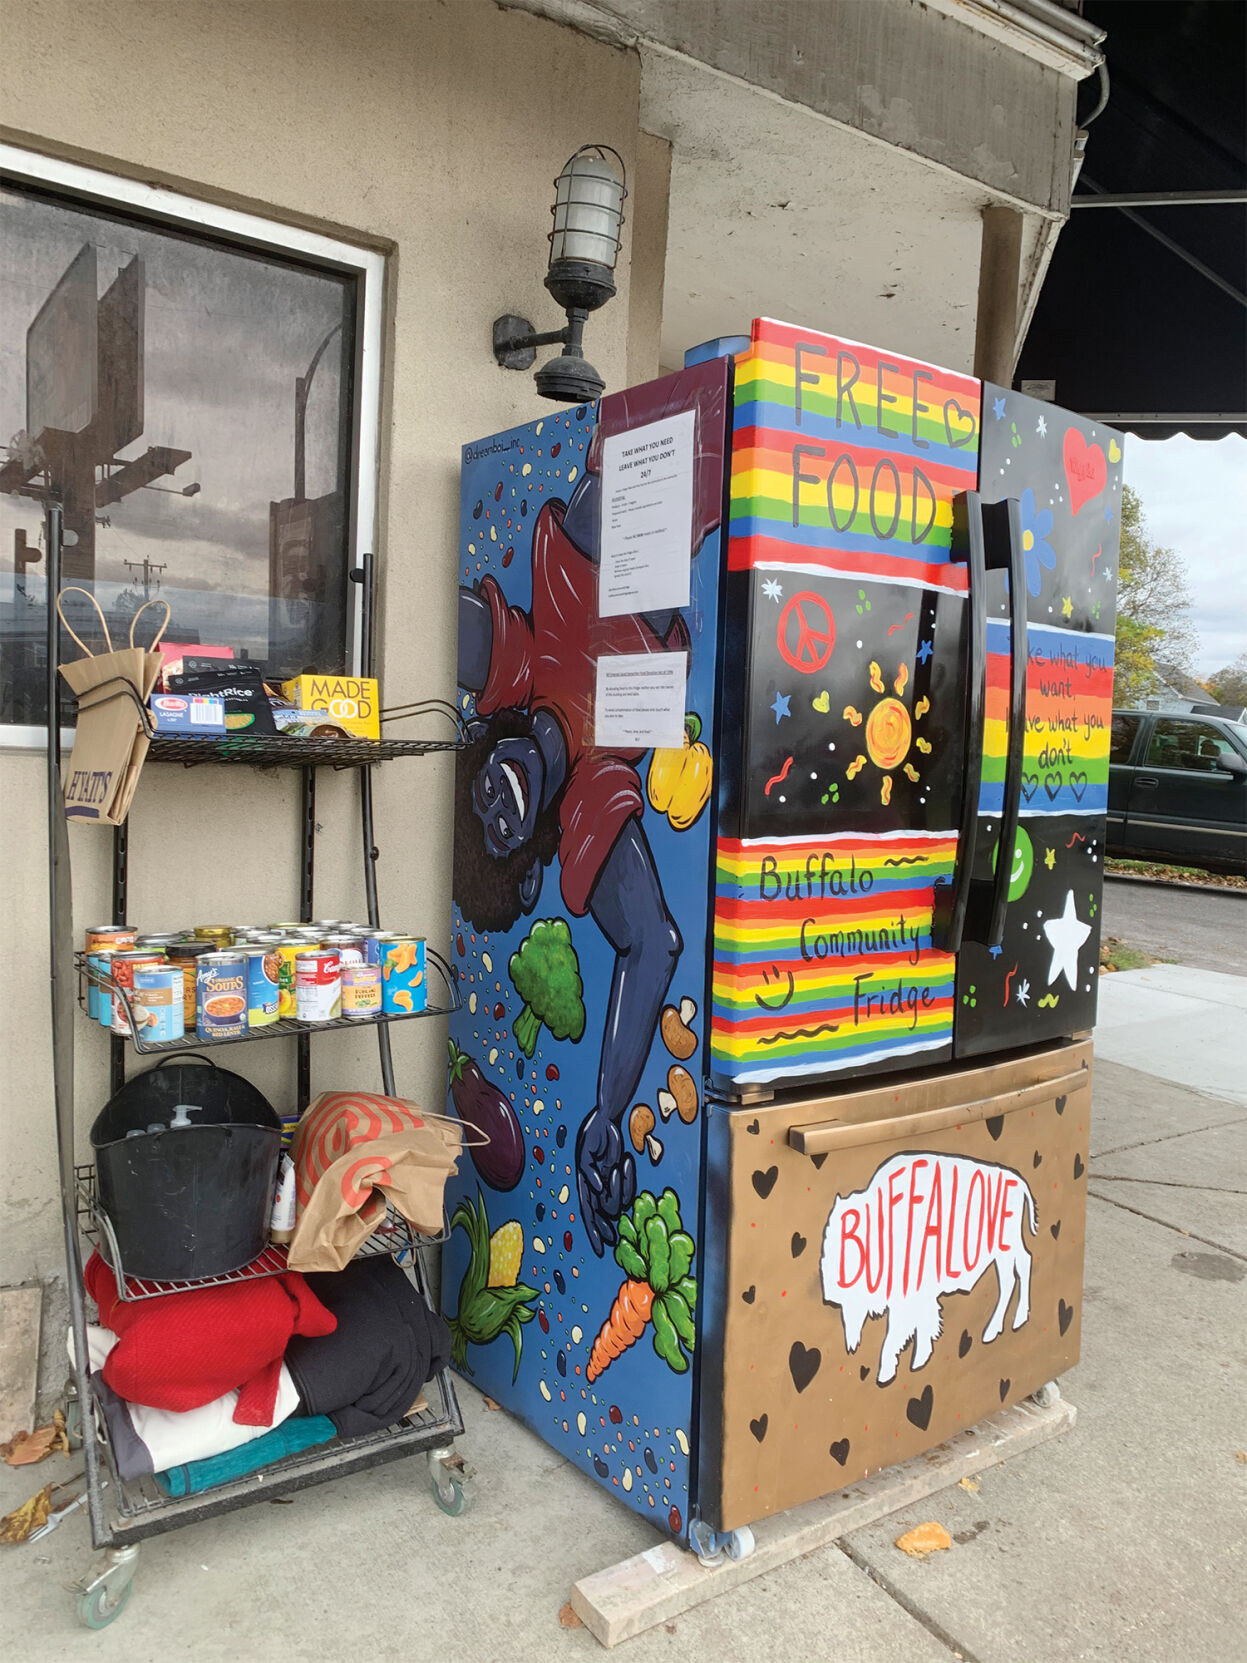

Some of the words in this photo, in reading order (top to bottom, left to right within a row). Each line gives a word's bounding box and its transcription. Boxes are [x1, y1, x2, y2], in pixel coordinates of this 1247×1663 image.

[795, 341, 933, 449] FREE
[619, 462, 633, 472] LEAVE
[634, 457, 648, 467] WHAT
[648, 454, 660, 463] YOU
[660, 449, 676, 460] DON'T
[622, 448, 633, 458] TAKE
[634, 444, 649, 454] WHAT
[649, 441, 660, 450] YOU
[660, 436, 674, 446] NEED
[640, 469, 652, 479] 24/7
[793, 444, 936, 545] FOOD
[1049, 643, 1080, 671] what
[1085, 652, 1107, 679] you
[311, 679, 370, 699] MADE
[311, 698, 372, 719] GOOD
[1005, 707, 1045, 733] lve
[1048, 707, 1079, 733] what
[1084, 713, 1104, 741] you
[1037, 738, 1073, 769] don't
[760, 852, 874, 901] Buffalo
[800, 914, 920, 966] Community
[206, 975, 244, 992] SOUPS
[853, 972, 935, 1031] Fridge
[837, 1159, 1019, 1301] BUFFALOVE
